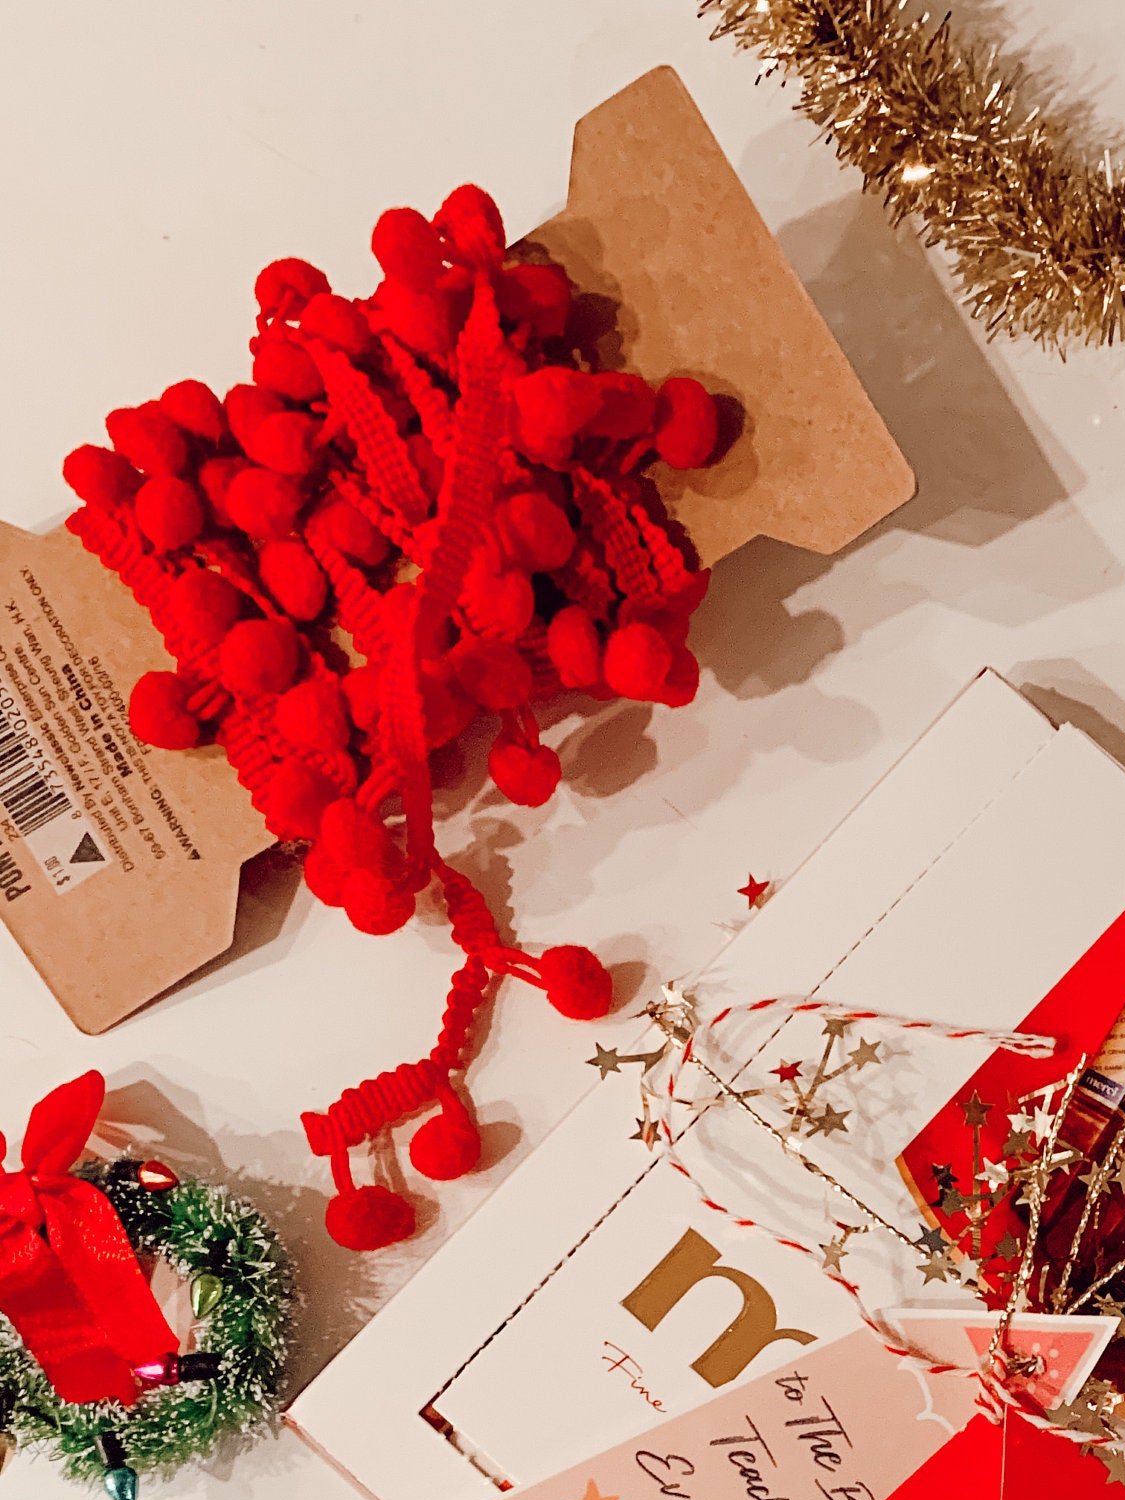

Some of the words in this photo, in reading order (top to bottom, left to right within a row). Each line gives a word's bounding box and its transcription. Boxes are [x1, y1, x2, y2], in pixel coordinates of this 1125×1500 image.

[36, 596, 84, 666] DECORATION
[36, 685, 56, 712] Sun
[59, 663, 93, 712] China
[100, 732, 133, 778] Made
[602, 1341, 667, 1412] Fine
[776, 1371, 808, 1405] to
[785, 1395, 853, 1472] The
